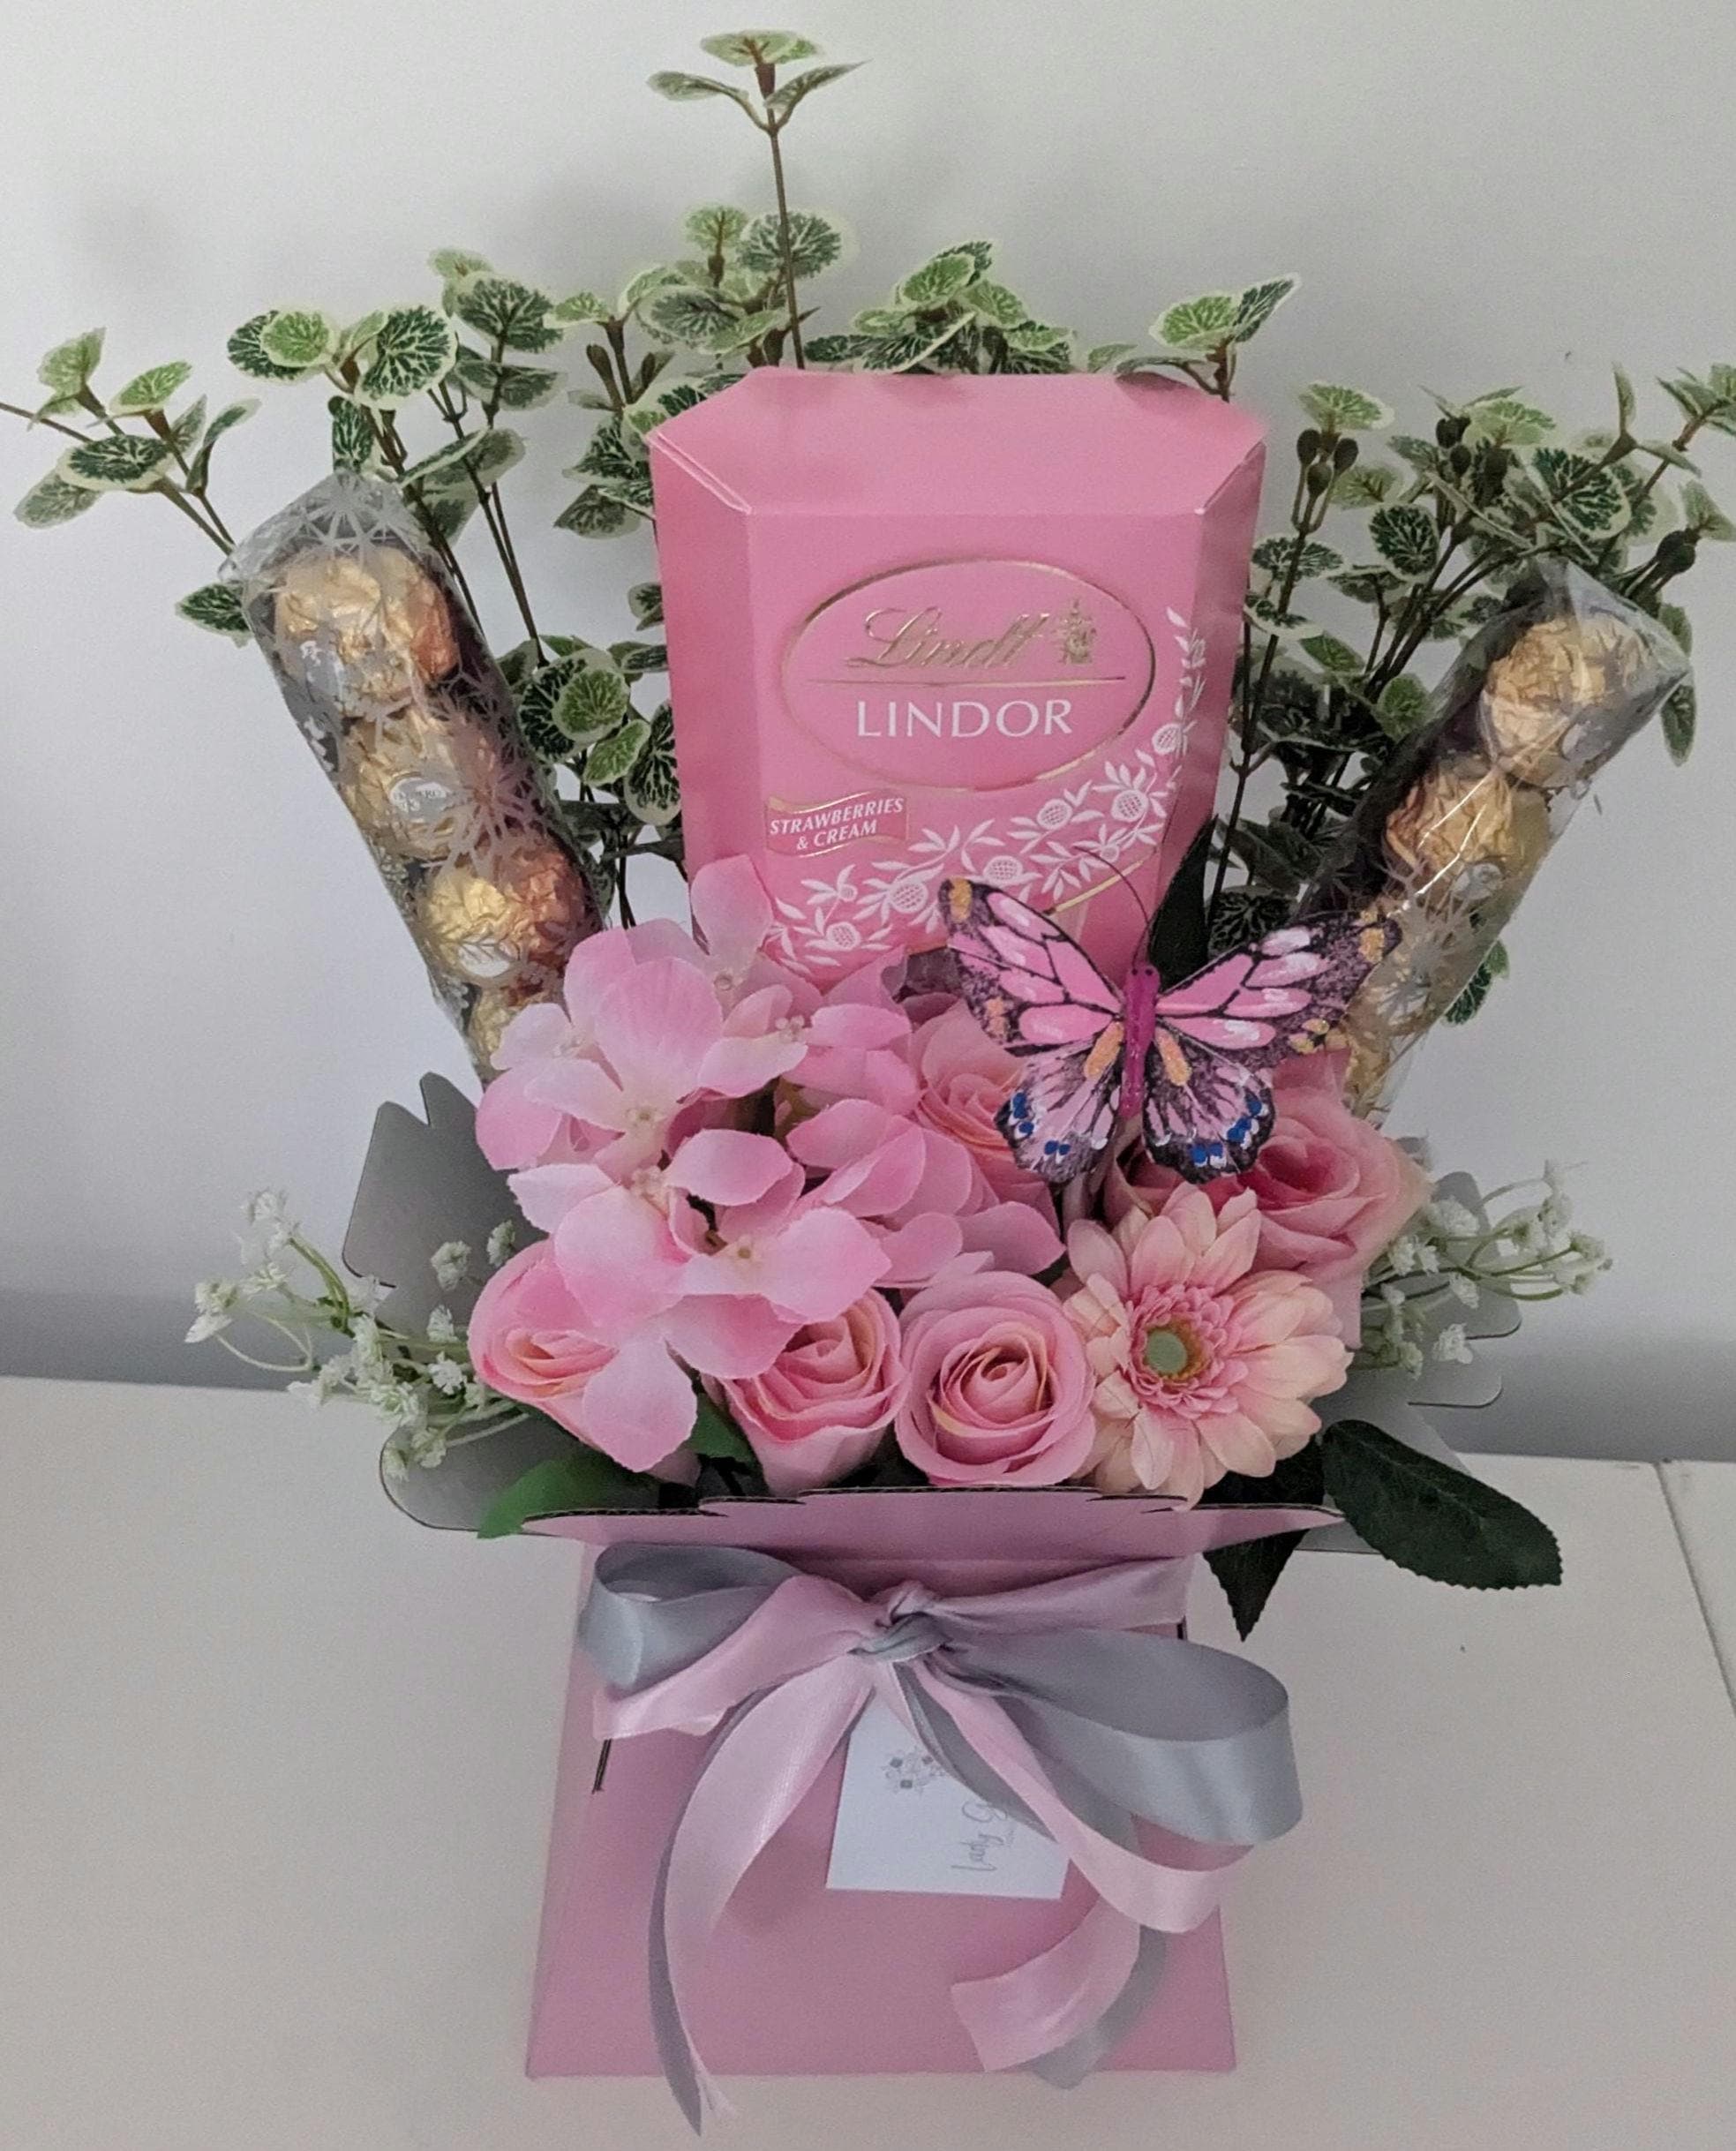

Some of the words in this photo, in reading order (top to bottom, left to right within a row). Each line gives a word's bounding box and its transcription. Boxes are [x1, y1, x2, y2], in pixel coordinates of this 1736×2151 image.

[845, 605, 1050, 668] Lindt
[857, 699, 1072, 738] LINDOR
[770, 797, 905, 835] STRAWBERRIES
[796, 835, 809, 851] &
[813, 819, 877, 847] CREAM
